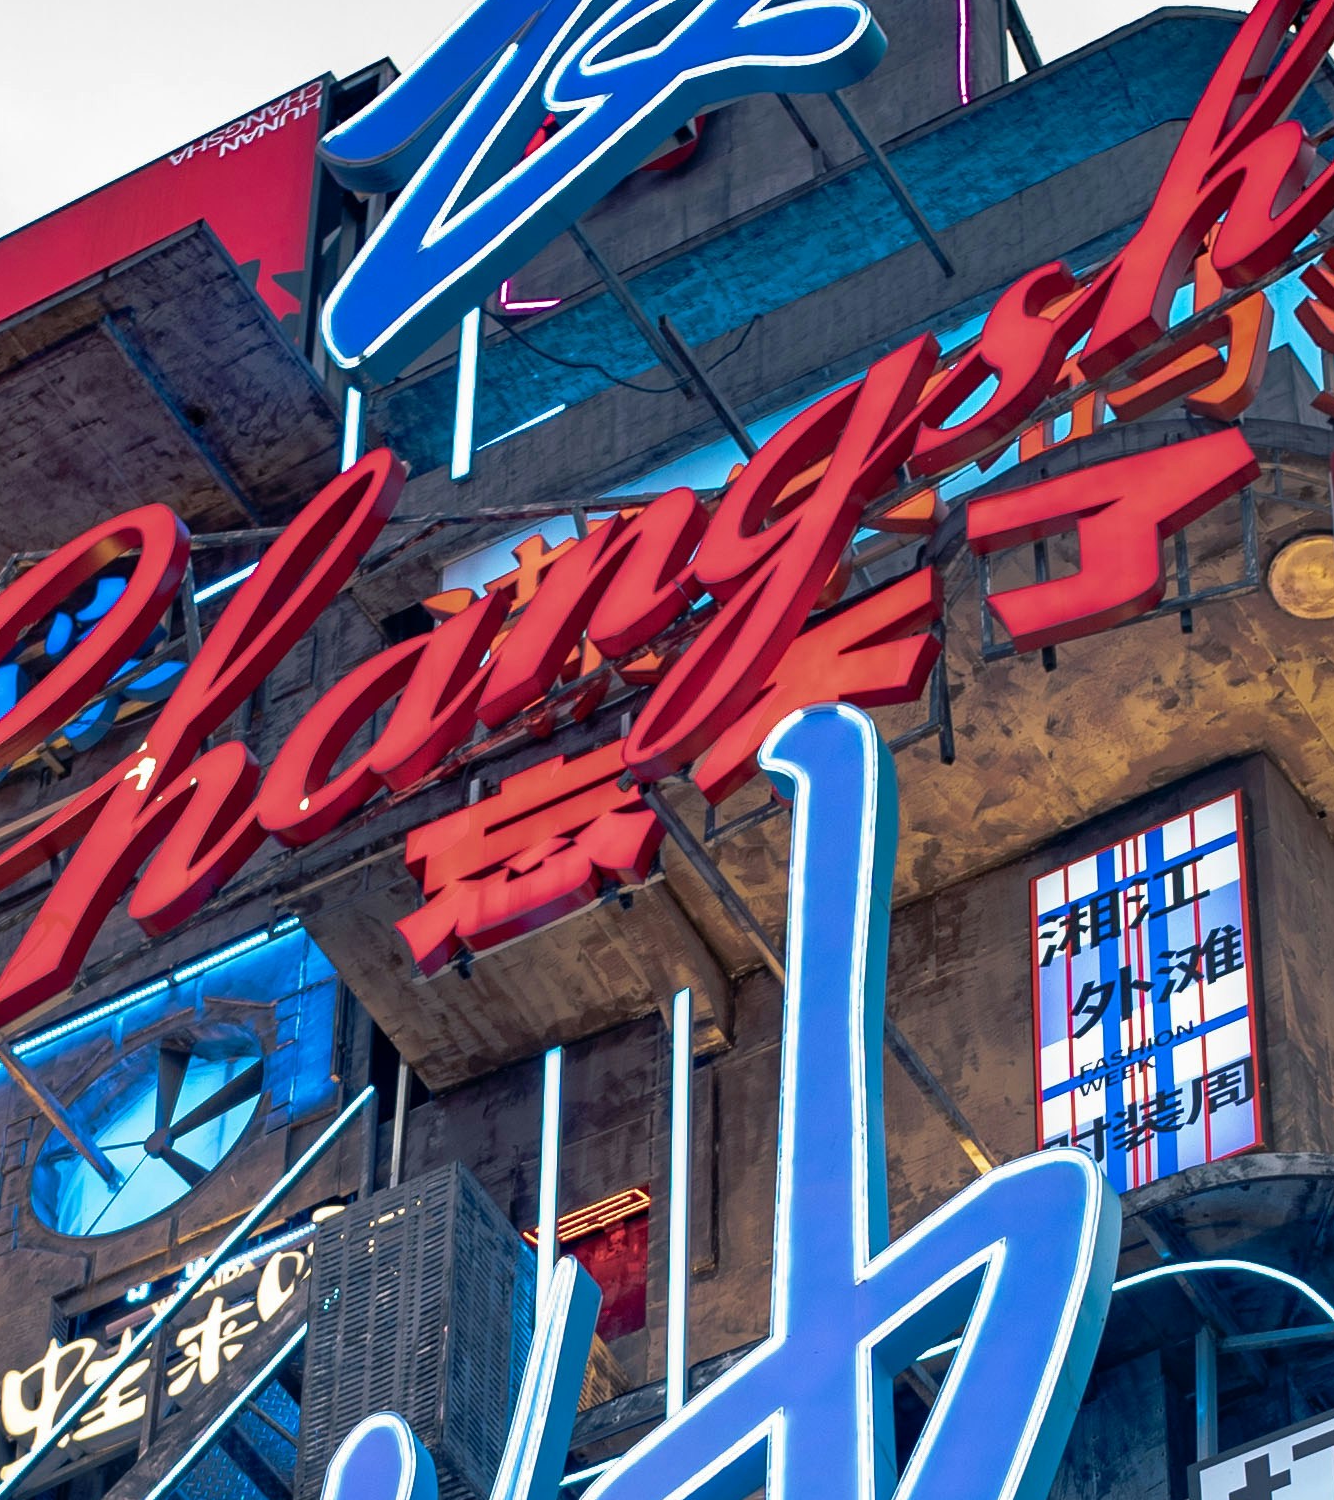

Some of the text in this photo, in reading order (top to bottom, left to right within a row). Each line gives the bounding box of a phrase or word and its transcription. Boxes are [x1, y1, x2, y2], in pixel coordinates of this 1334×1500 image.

[168, 78, 324, 168] CHANGSHA
[216, 94, 324, 159] HUNAN
[1037, 853, 1212, 969] 湘江
[1069, 923, 1246, 1040] 外滩
[1078, 1018, 1195, 1082] FASHION
[1078, 1054, 1158, 1098] WEEK
[0, 1203, 349, 1483] 蛙来
